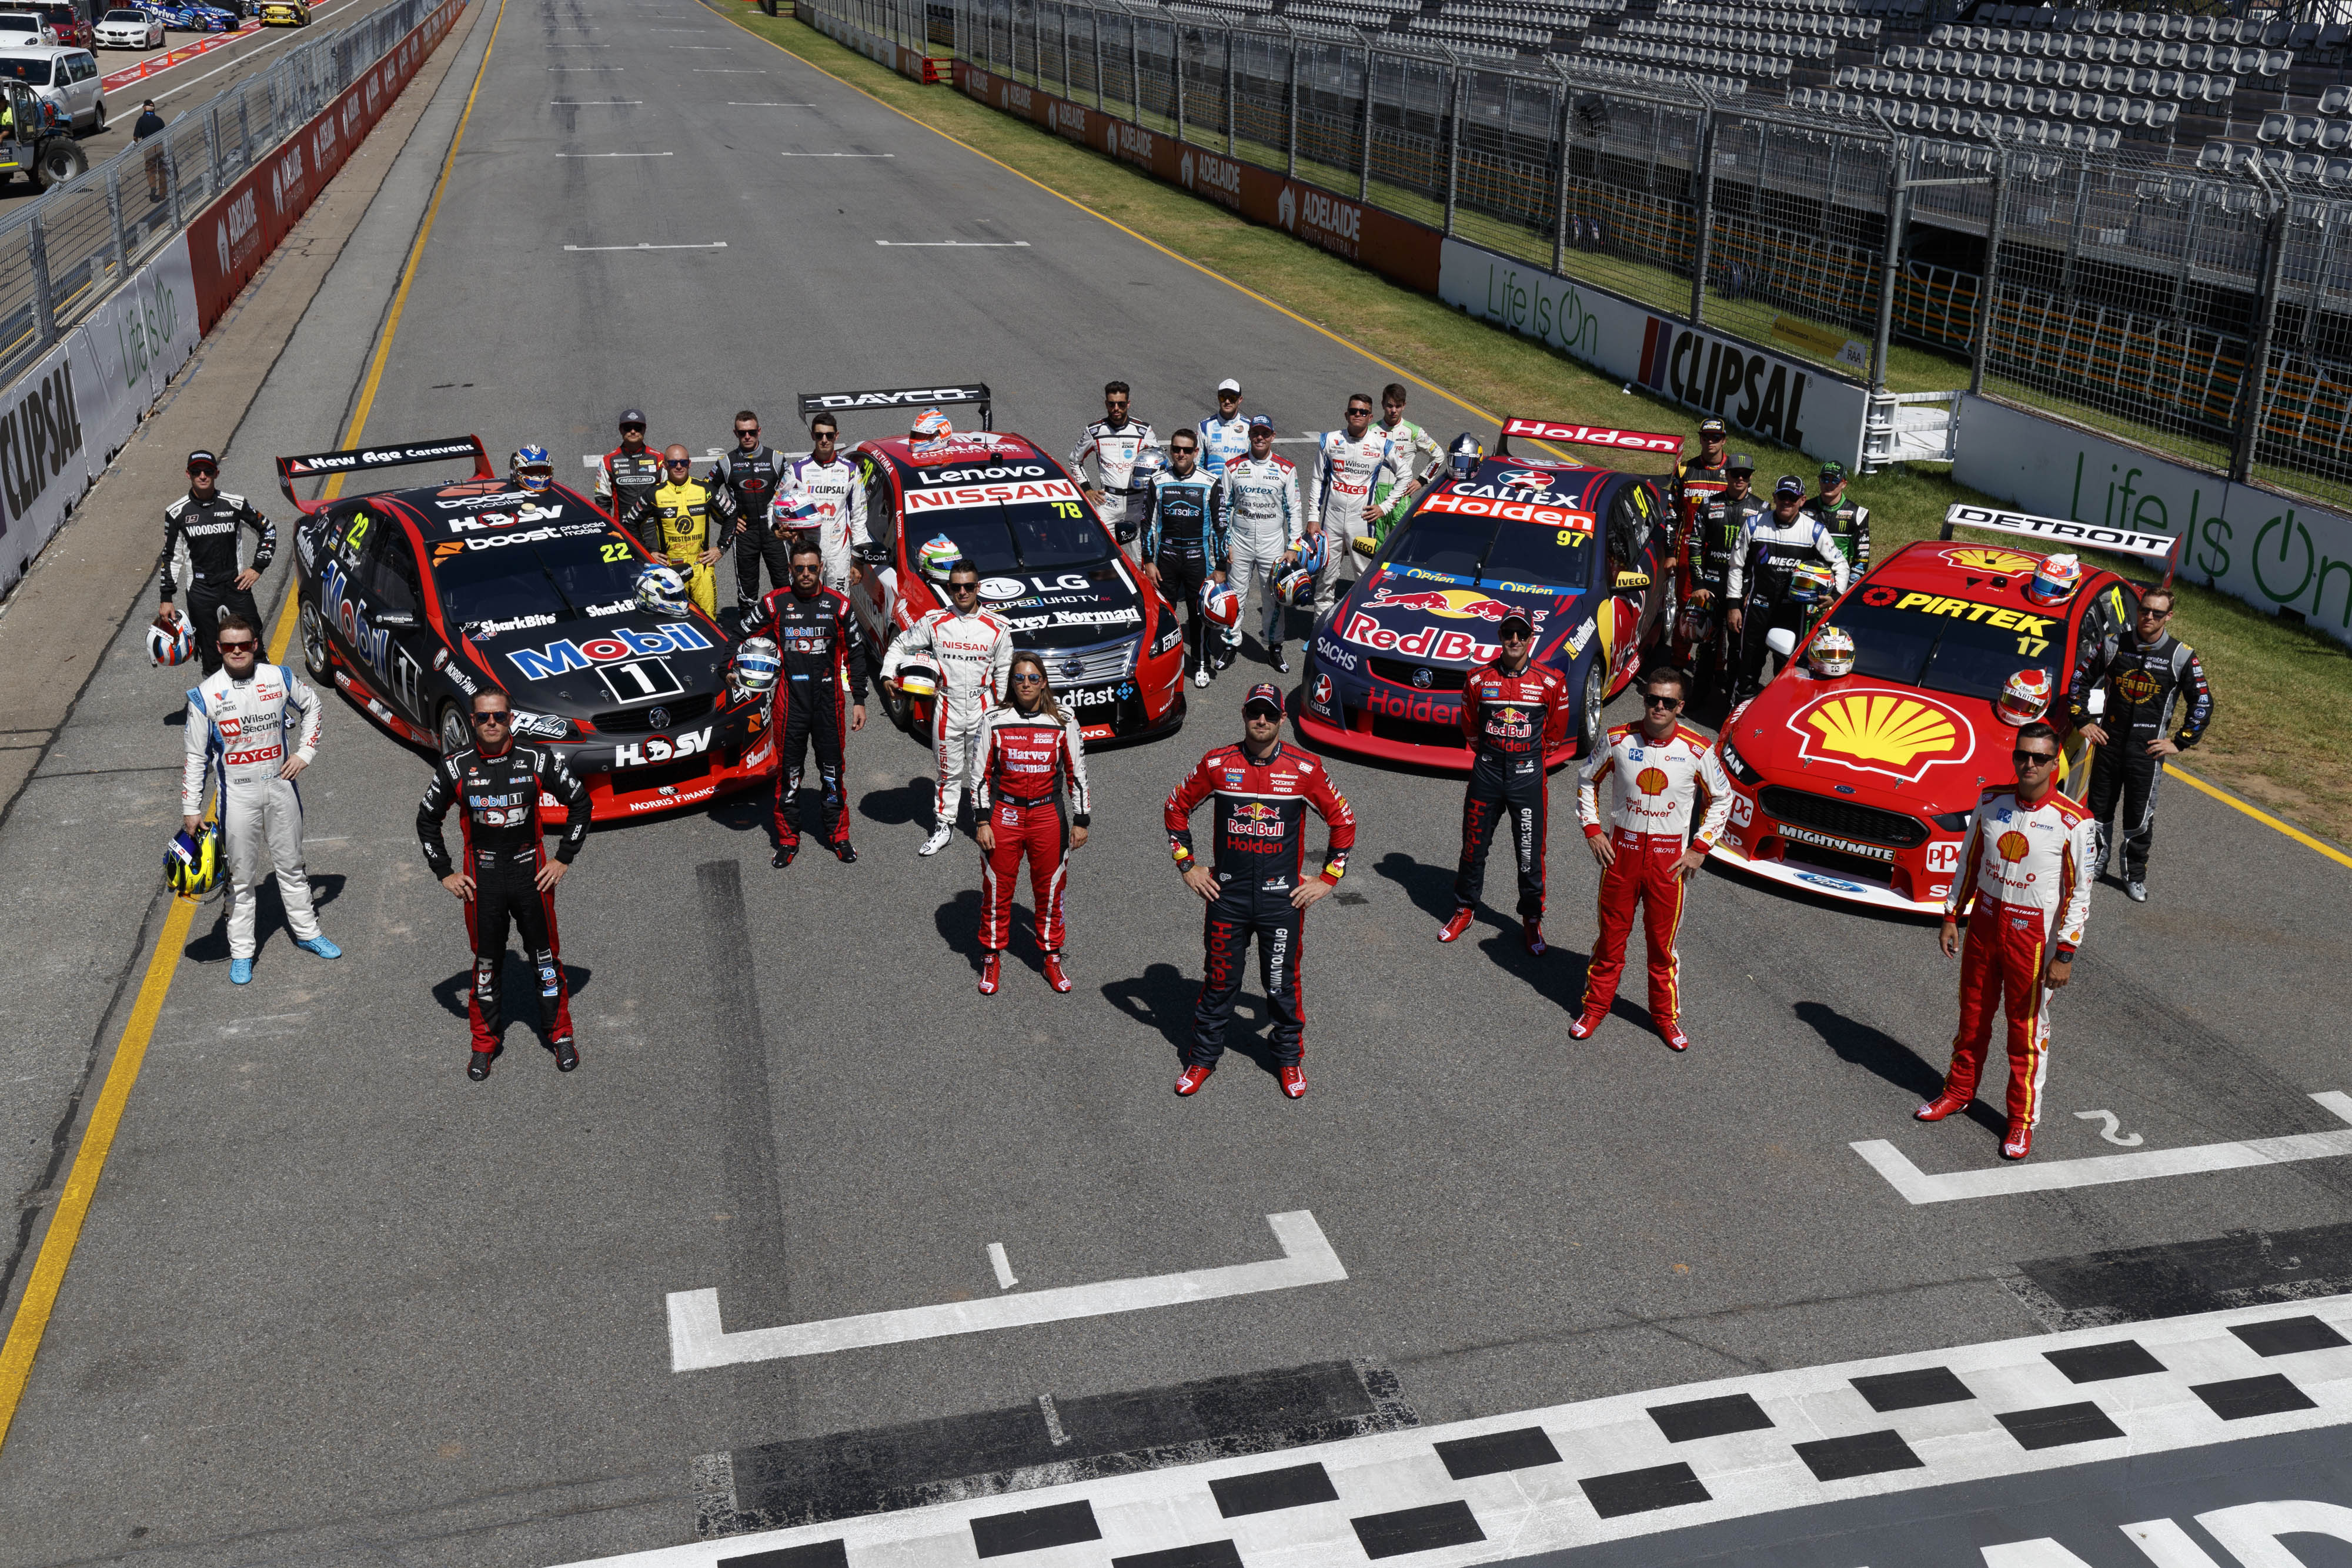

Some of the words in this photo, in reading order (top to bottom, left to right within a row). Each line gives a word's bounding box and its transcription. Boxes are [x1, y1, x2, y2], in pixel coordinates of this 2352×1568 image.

[1060, 103, 1085, 131] ADELAIDE
[1121, 125, 1152, 159] ADELAIDE
[1199, 154, 1240, 194] ADELAIDE
[228, 188, 257, 246] ADELAIDE
[1302, 192, 1361, 242] ADELAIDE
[1488, 263, 1526, 322] Life
[1534, 281, 1552, 336] Is
[1559, 286, 1598, 353] On
[1847, 349, 1861, 364] RAA
[820, 389, 966, 407] DAYCO
[1670, 331, 1806, 448] CLIPSAL
[0, 360, 82, 521] CLIPSAL
[1508, 421, 1677, 450] Holden
[313, 455, 355, 469] New
[362, 450, 402, 463] Age
[406, 443, 474, 457] Caravans
[871, 449, 893, 475] ALTIMA
[1345, 460, 1369, 469] Wilson
[918, 466, 1045, 484] Lenovo
[815, 486, 844, 494] CLIPSAL
[908, 483, 1072, 509] NISSAN
[1238, 486, 1273, 494] Vortex
[1334, 482, 1365, 493] PAYCE
[1452, 483, 1579, 509] CALTEX
[435, 490, 540, 509] boost
[466, 499, 523, 510] mobile
[1633, 485, 1649, 519] 97
[185, 514, 199, 523] 19
[1051, 503, 1083, 519] 78
[1164, 507, 1199, 517] carsales
[1243, 510, 1276, 519] GEARWRENCH
[1423, 494, 1592, 530] Holden
[186, 523, 235, 537] WOODSTOCK
[346, 513, 369, 550] 22
[465, 527, 562, 550] boost
[560, 521, 606, 531] pre-paid
[564, 529, 602, 537] mobile
[1957, 508, 2170, 549] DETROIT
[2184, 489, 2234, 577] Is
[1353, 539, 1372, 553] IVECO
[1556, 530, 1585, 547] 97
[600, 543, 633, 563] 22
[1768, 556, 1802, 567] MEGA
[1030, 574, 1090, 592] LG
[1407, 569, 1455, 583] O'Brien
[1618, 577, 1647, 586] IVECO
[1500, 581, 1553, 595] O'Brien
[2111, 586, 2125, 624] 17
[480, 613, 556, 631] SharkBite
[1895, 593, 2056, 637] PIRTEK
[321, 560, 389, 689] Mobil
[785, 627, 813, 637] Mobil
[1569, 616, 1596, 651] GEARWRENCH
[507, 623, 713, 680] Mobil
[943, 641, 988, 651] NISSAN
[1317, 636, 1357, 671] SACHS
[2017, 636, 2049, 657] 17
[620, 663, 657, 694] 1
[1544, 677, 1556, 687] OMP
[2116, 677, 2161, 694] PENRITE
[260, 692, 282, 701] PAYCE
[1310, 700, 1331, 717] CALTEX
[240, 711, 277, 725] Wilson
[242, 720, 281, 734] Security
[1486, 720, 1507, 735] Red
[1508, 724, 1532, 738] Bull
[226, 736, 251, 744] Racing
[1486, 736, 1530, 752] Holden
[228, 747, 278, 763] PAYCE
[1007, 748, 1051, 763] Harvey
[1629, 748, 1643, 761] PPG
[1692, 746, 1705, 755] OMP
[1005, 761, 1051, 773] Norman
[1208, 758, 1221, 767] OMP
[1299, 764, 1312, 773] OMP
[470, 795, 507, 807] Mobil
[630, 796, 674, 811] MORRIS
[676, 785, 720, 803] FINANCE
[1626, 797, 1642, 806] Shell
[1626, 805, 1671, 817] V-Power
[1228, 818, 1254, 835] Red
[1256, 820, 1284, 837] Bull
[2064, 815, 2077, 825] OMP
[1464, 798, 1487, 862] Holden
[1228, 836, 1282, 854] Holden
[1618, 841, 1639, 850] PAYCE
[1779, 824, 1894, 860] MIGHTYMITE
[1986, 860, 2000, 870] Shell
[1805, 874, 1852, 891] Ford
[1985, 870, 2030, 890] V-Power
[2004, 907, 2040, 916] COULTHARD
[1211, 921, 1232, 990] Holden
[2073, 1109, 2143, 1146] 2
